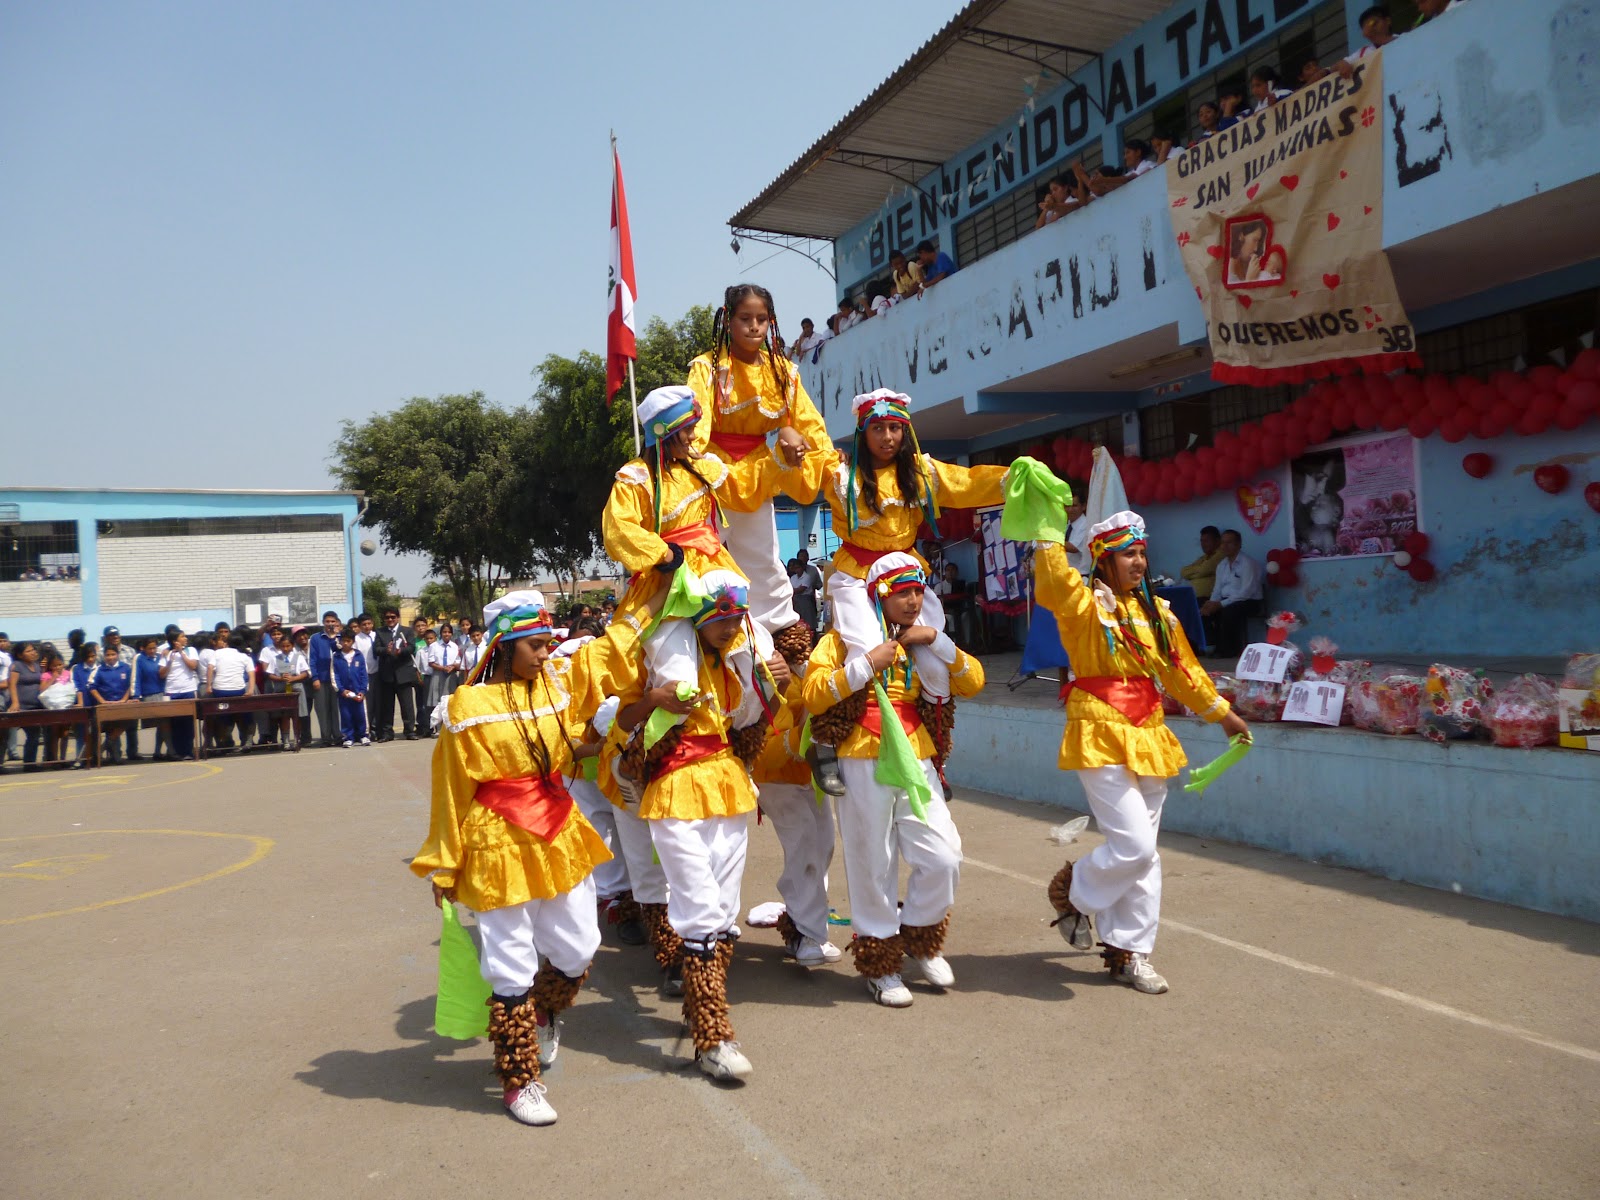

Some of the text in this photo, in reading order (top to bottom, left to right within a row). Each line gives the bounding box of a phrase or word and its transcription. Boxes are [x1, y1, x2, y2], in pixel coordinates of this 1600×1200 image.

[869, 84, 1089, 268] BIENVENIDO
[1105, 43, 1157, 125] AL
[1177, 110, 1267, 178] GRACIAS
[1275, 63, 1366, 136] MADRES
[1193, 171, 1231, 210] SAN
[1243, 105, 1358, 187] JUANINAS
[1218, 308, 1360, 347] QUEREMOS
